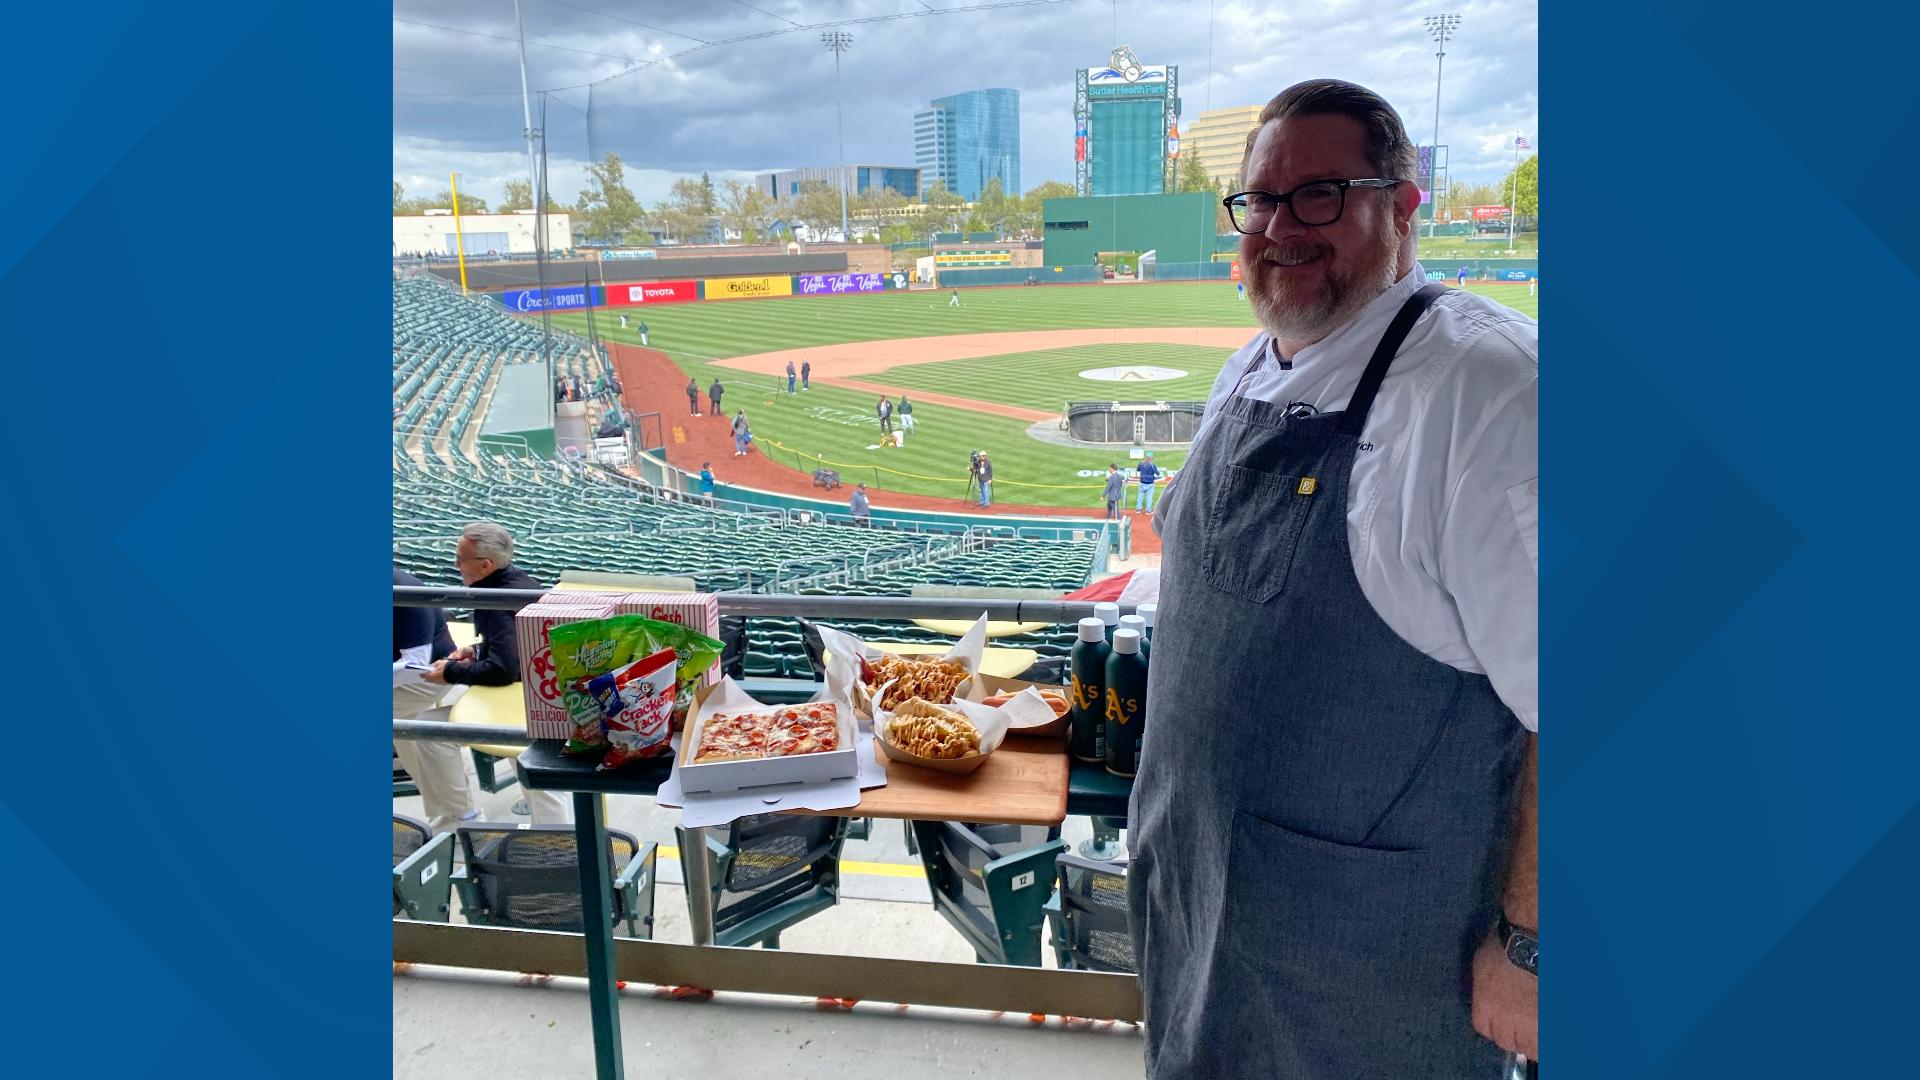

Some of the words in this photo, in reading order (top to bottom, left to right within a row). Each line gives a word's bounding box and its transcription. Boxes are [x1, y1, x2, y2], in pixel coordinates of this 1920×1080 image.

[1089, 87, 1114, 96] Sutter
[1116, 85, 1145, 95] Health
[1145, 84, 1166, 94] Park
[1424, 271, 1445, 280] alth
[644, 288, 675, 297] TOYOTA
[556, 293, 585, 306] SPORTS
[1072, 673, 1099, 710] A's
[621, 692, 671, 723] Cracker
[1105, 687, 1137, 725] A's
[531, 710, 567, 722] DELICIOU
[634, 710, 663, 734] Jack
[1020, 875, 1027, 886] 12
